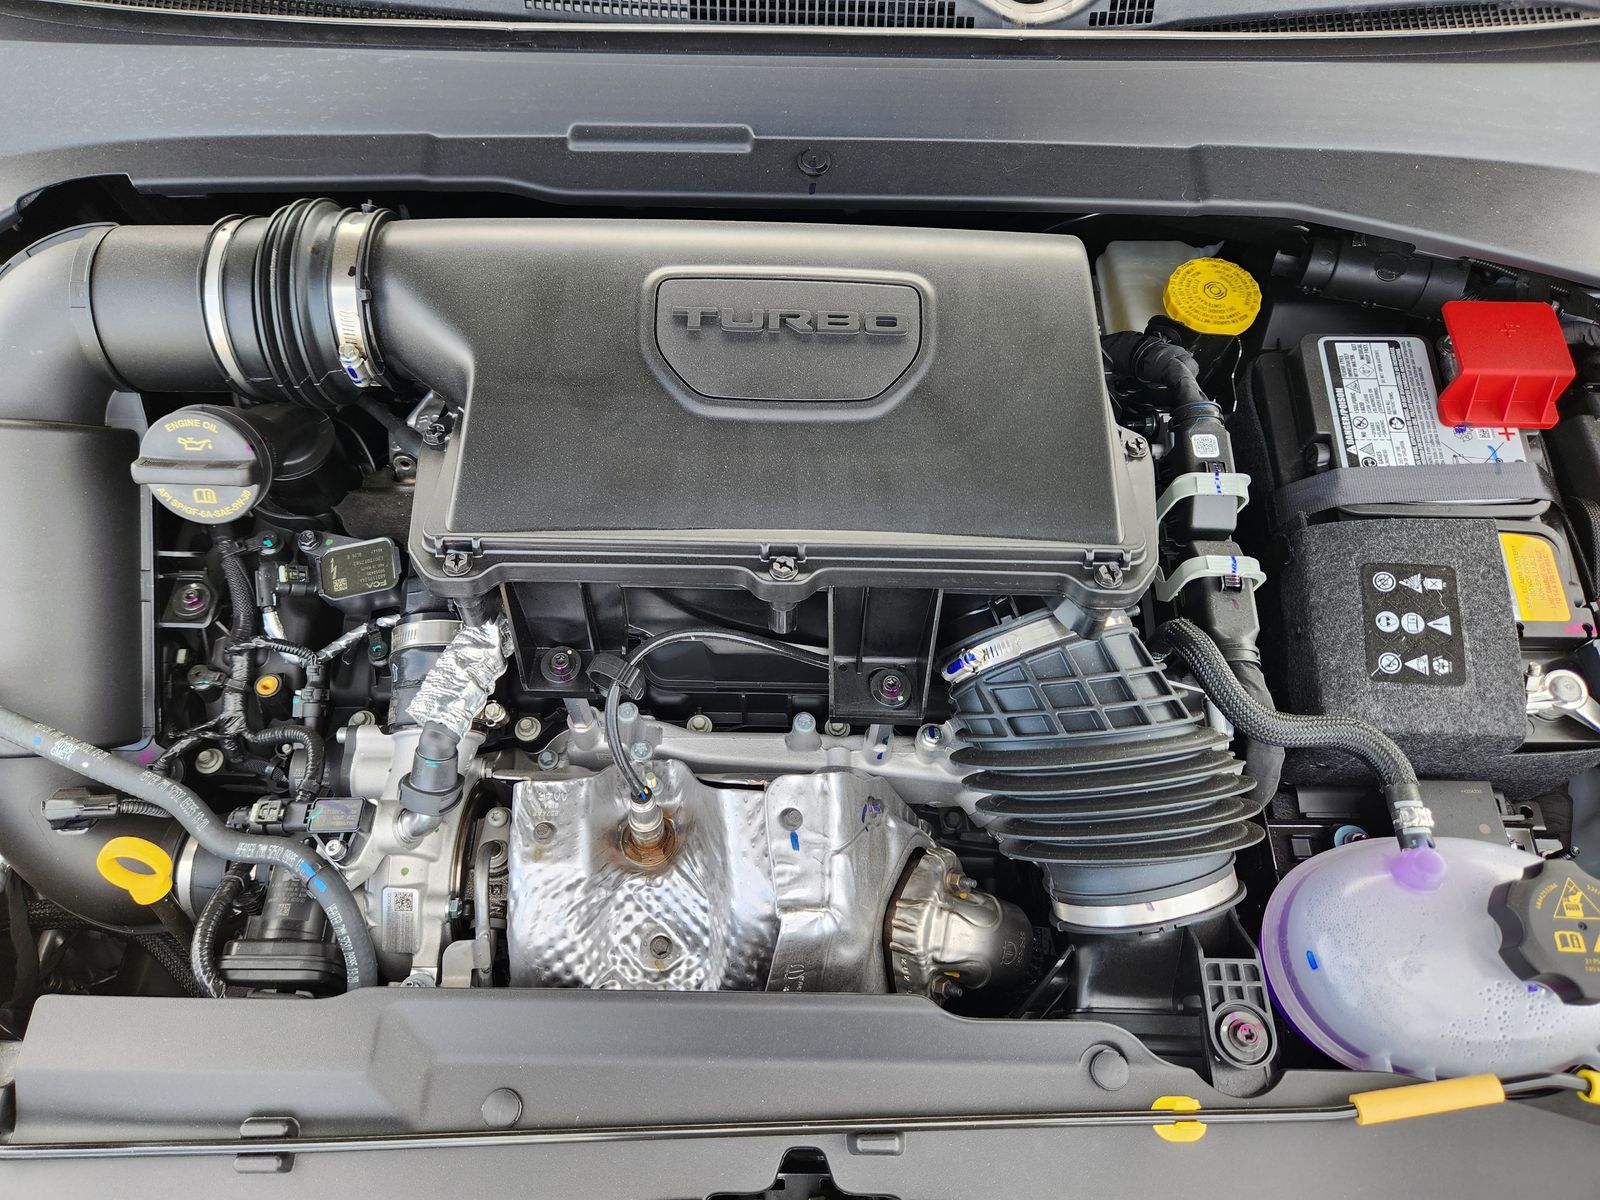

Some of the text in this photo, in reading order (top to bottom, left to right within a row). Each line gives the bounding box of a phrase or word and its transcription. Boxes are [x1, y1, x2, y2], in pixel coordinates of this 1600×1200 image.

[672, 306, 908, 335] TURBO
[1335, 387, 1354, 445] DANGER/POISON
[165, 418, 218, 434] ENGINE OIL
[157, 488, 172, 502] API
[365, 578, 386, 588] FCA
